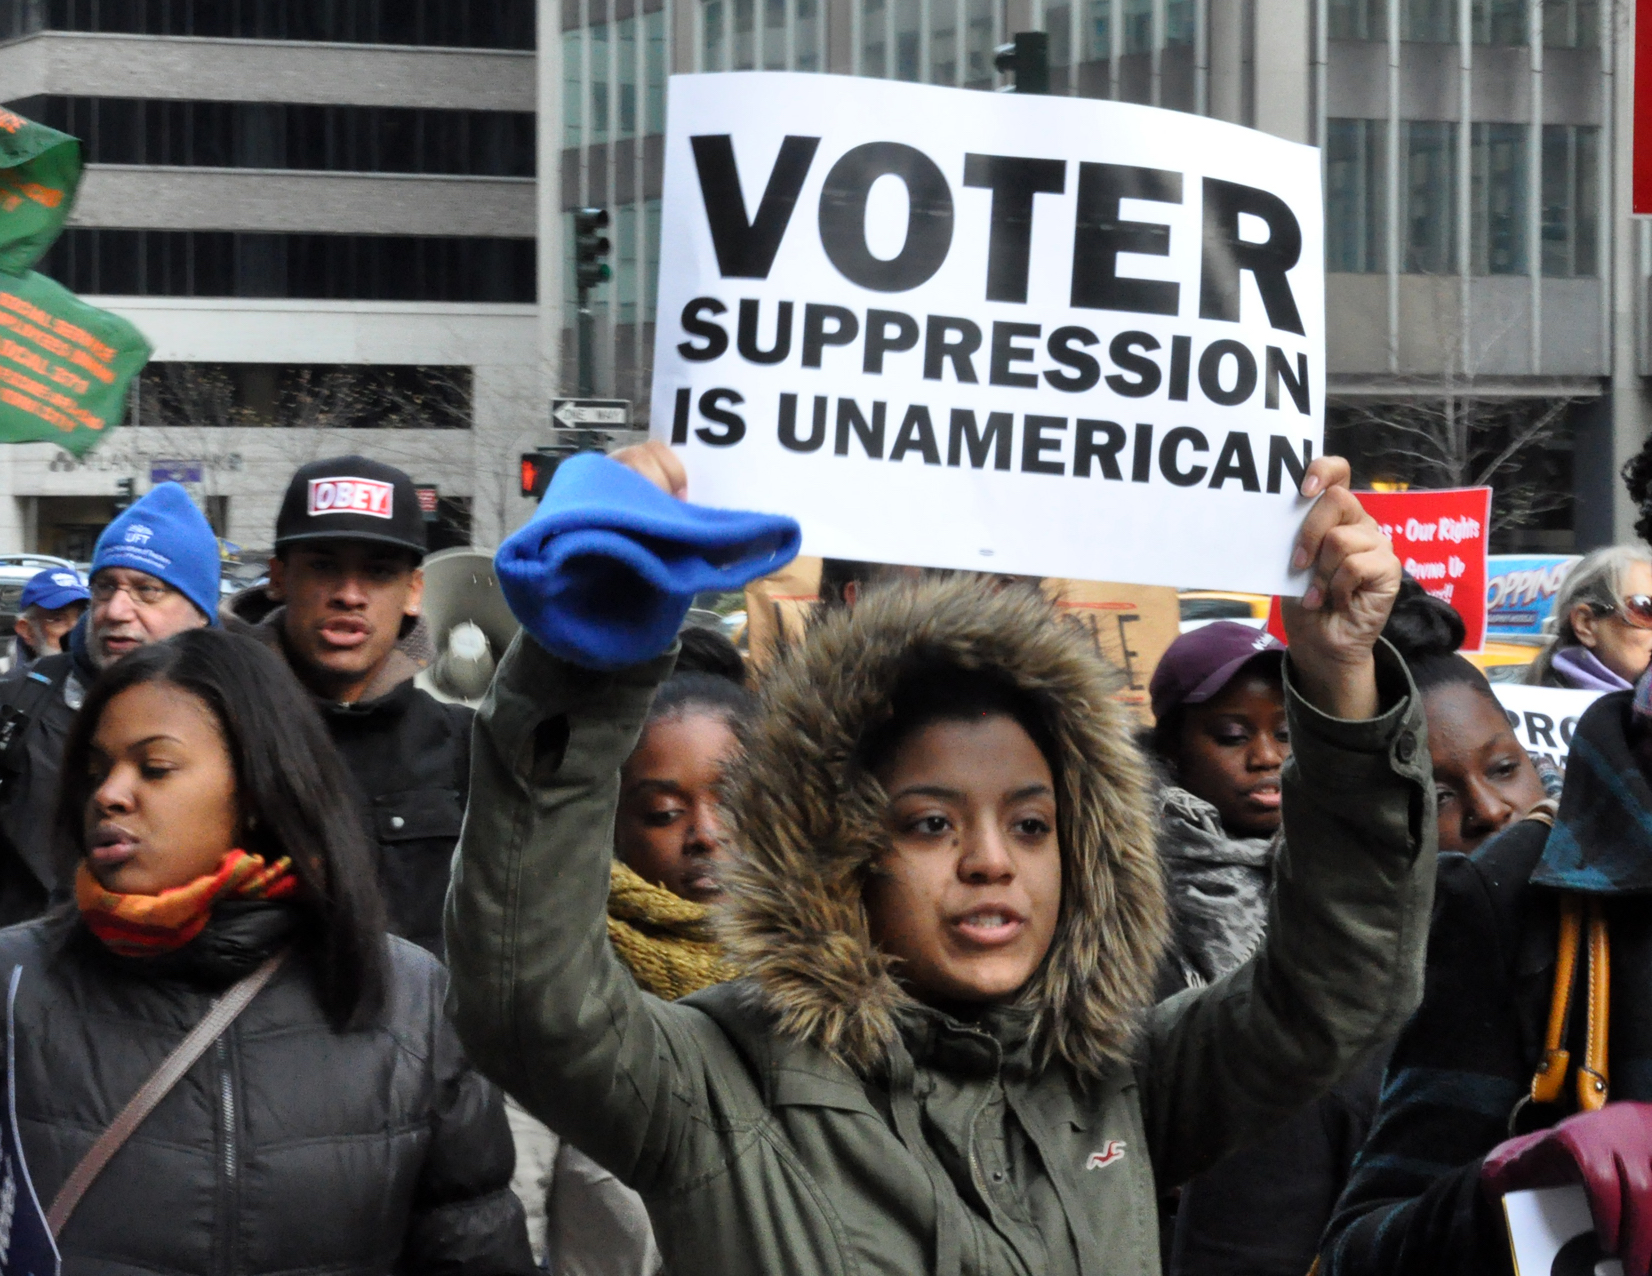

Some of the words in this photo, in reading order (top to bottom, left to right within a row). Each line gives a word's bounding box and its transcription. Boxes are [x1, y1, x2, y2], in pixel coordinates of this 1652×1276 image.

[690, 134, 1306, 337] VOTER
[677, 296, 1310, 416] SUPPRESSION
[316, 482, 390, 512] OBEY
[671, 387, 746, 447] IS
[777, 392, 1313, 497] UNAMERICAN
[1405, 517, 1437, 542] Our
[1437, 514, 1480, 544] Rights
